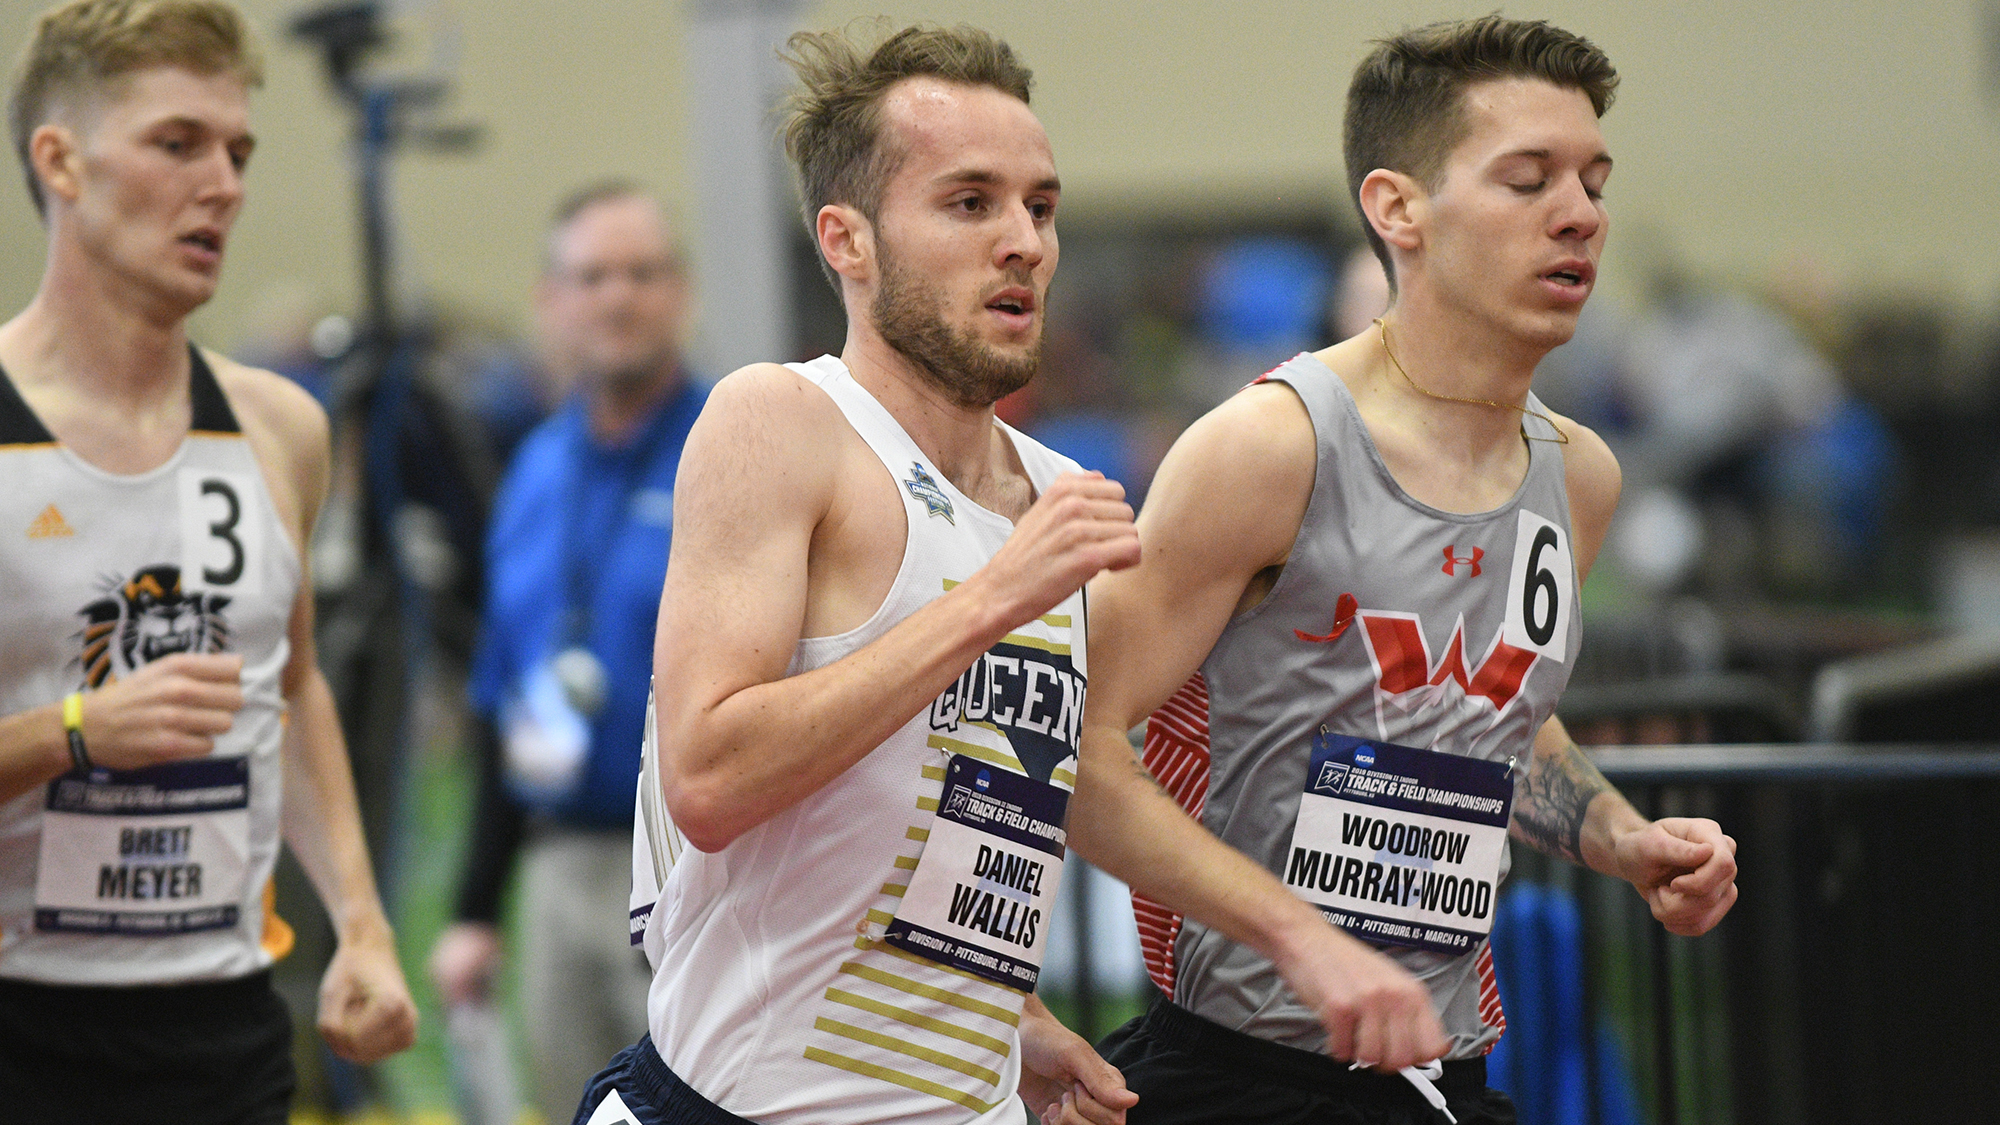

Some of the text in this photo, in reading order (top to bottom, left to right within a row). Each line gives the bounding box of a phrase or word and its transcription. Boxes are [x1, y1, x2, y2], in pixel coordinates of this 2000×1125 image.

[200, 477, 245, 586] 3
[1523, 525, 1558, 646] 6
[930, 651, 1086, 760] QUEEN
[1355, 754, 1375, 764] NCAA
[1367, 769, 1393, 780] DIVISION
[966, 797, 997, 819] TRACK
[995, 808, 1003, 822] &
[1002, 809, 1030, 831] FIELD
[1347, 773, 1504, 814] TRACK & FIELD CHAMPIONSHIPS
[119, 825, 192, 855] BRETT
[1342, 812, 1470, 864] WOODROW
[98, 863, 203, 899] MEYER
[973, 844, 1044, 897] DANIEL
[1287, 847, 1491, 919] MURRAY-WOOD
[947, 882, 1041, 949] WALLIS
[1346, 915, 1356, 928] II
[1361, 919, 1411, 939] PITTSBURG,
[1424, 929, 1453, 944] MARCH
[1453, 934, 1468, 947] 8-9
[907, 930, 944, 951] DIVISION
[954, 946, 999, 971] PITTSBURG,
